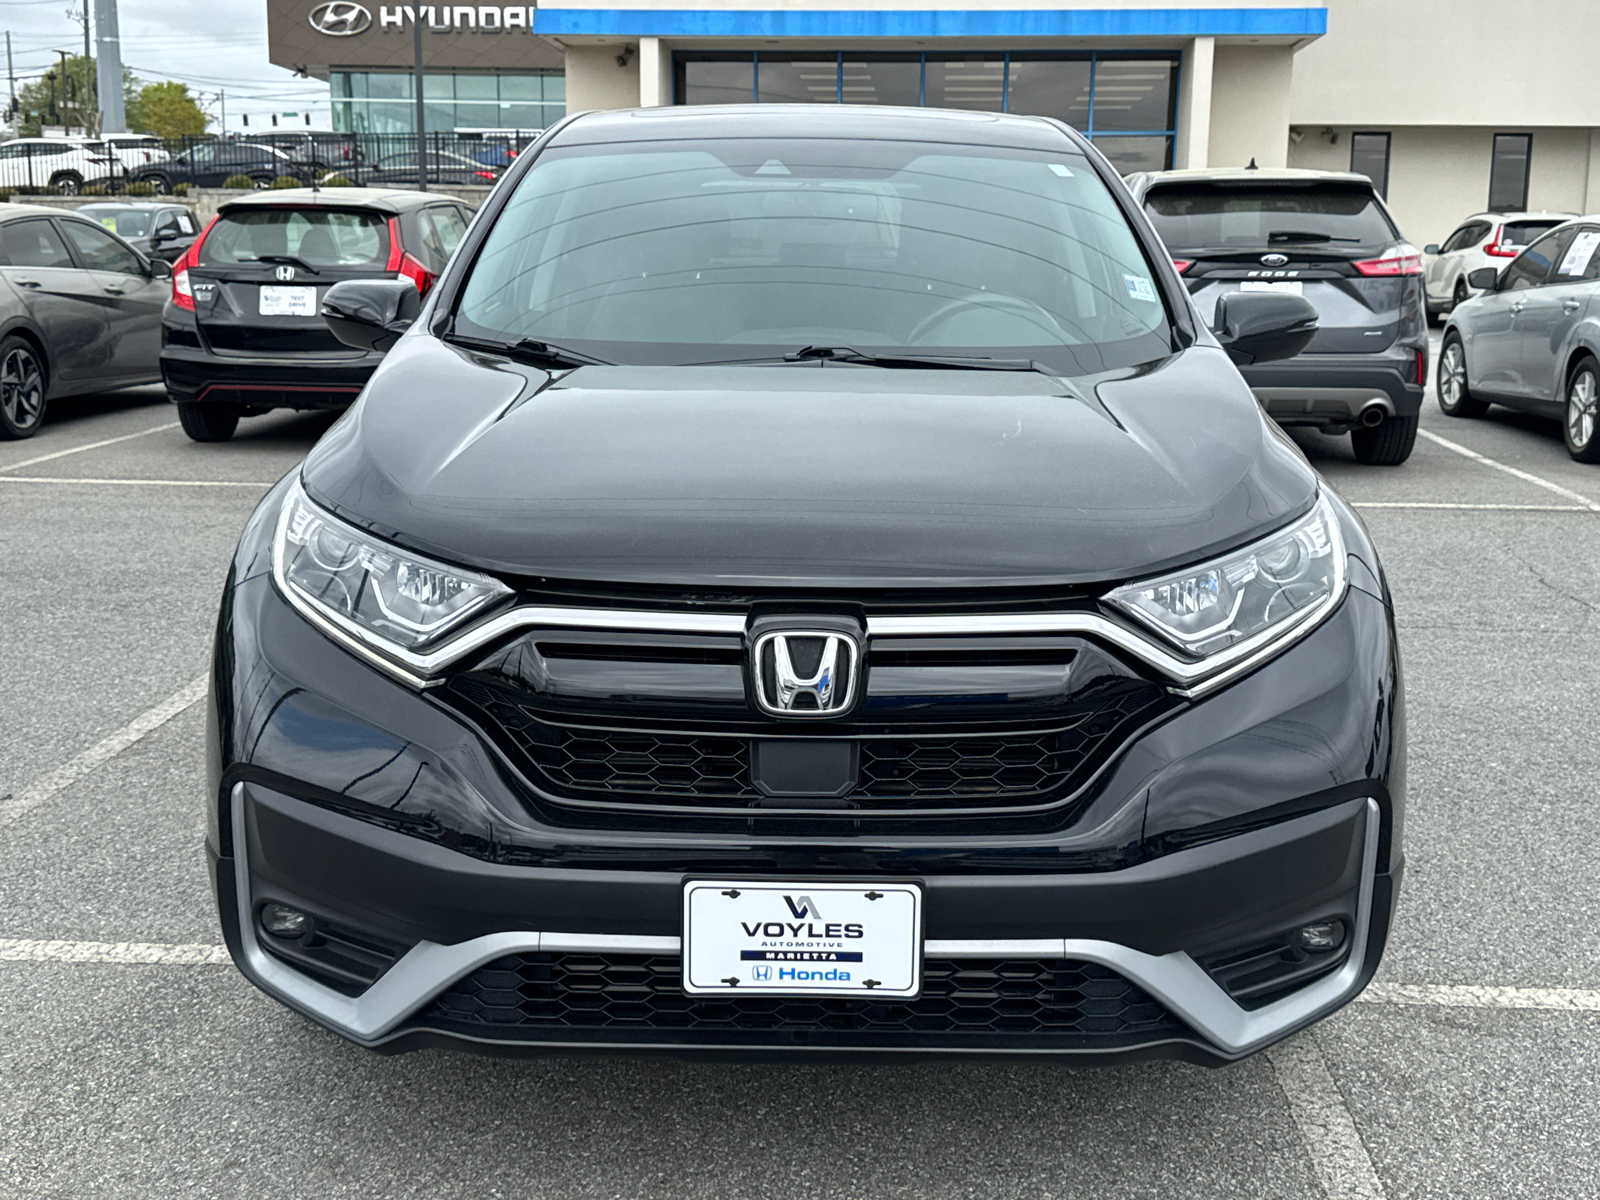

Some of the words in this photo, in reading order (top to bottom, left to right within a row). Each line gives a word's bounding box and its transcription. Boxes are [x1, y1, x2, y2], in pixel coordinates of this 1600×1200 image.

[741, 922, 864, 938] VOYLES
[765, 952, 837, 960] MARIETTA
[779, 967, 851, 981] Honda
